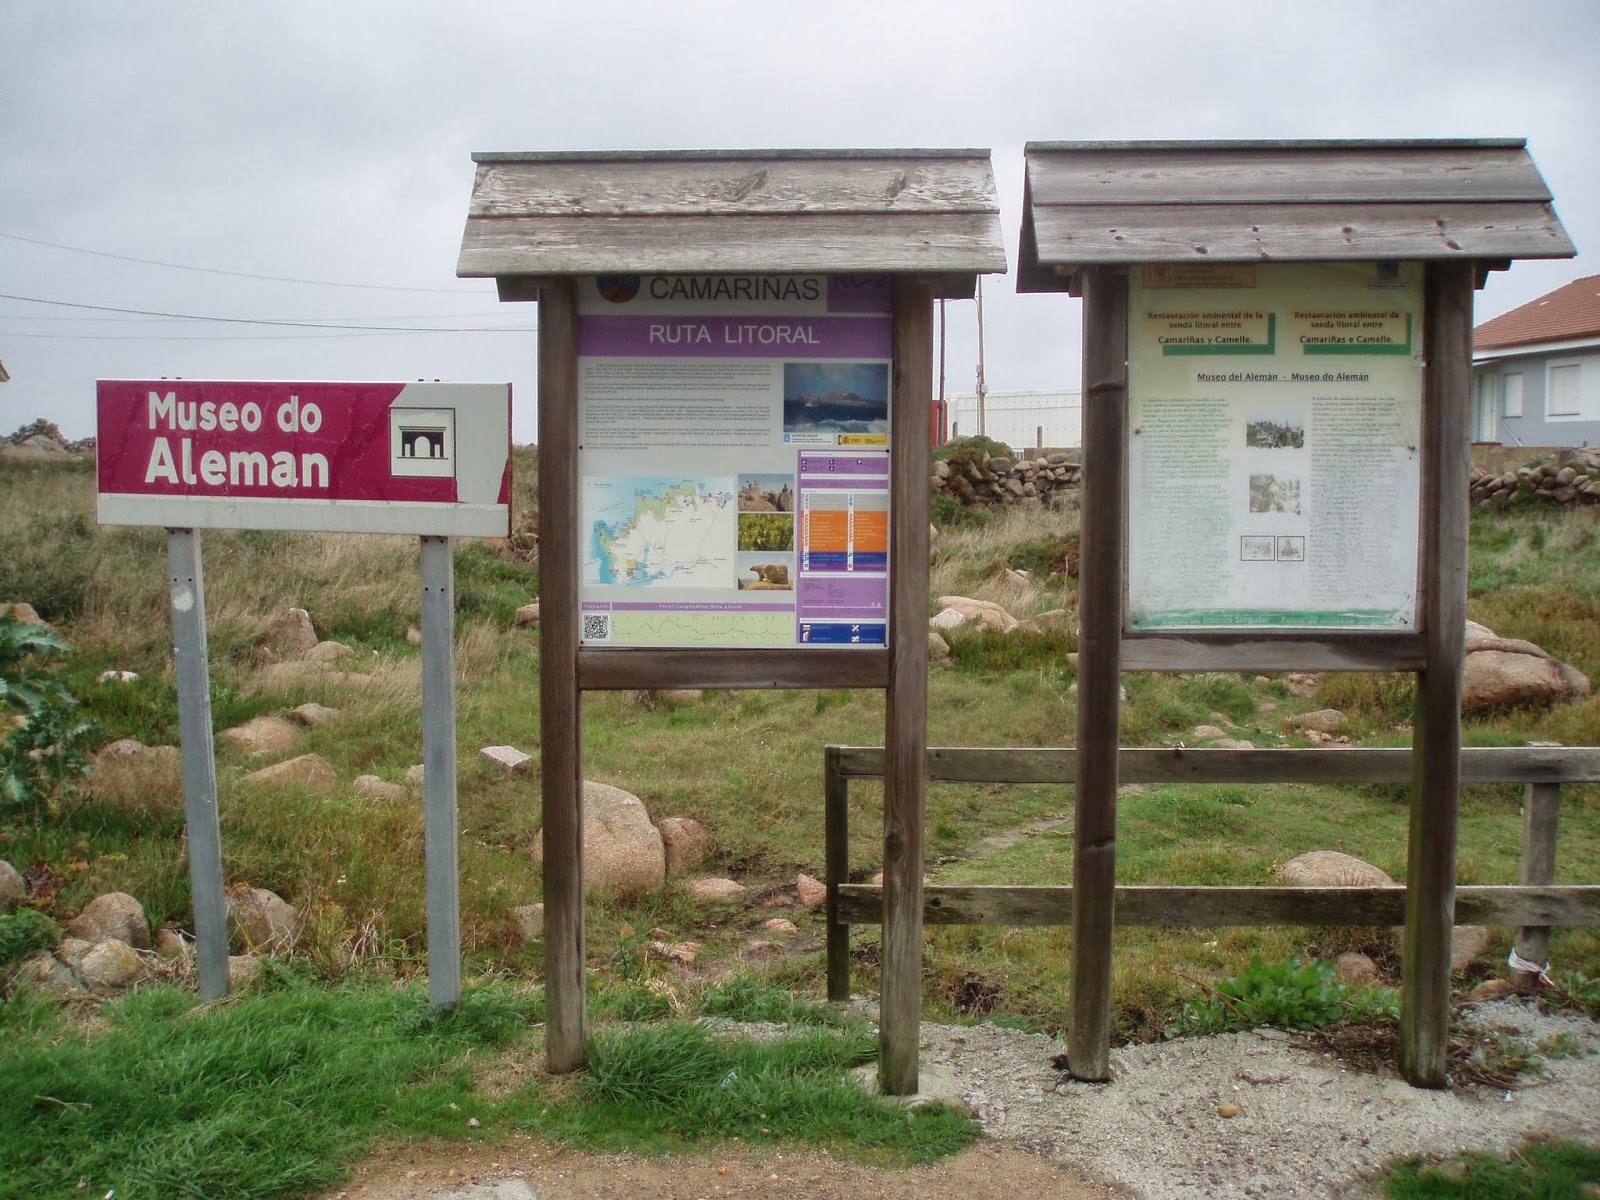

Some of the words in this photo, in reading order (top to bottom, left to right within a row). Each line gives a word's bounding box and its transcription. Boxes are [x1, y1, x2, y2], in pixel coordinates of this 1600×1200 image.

[1148, 311, 1200, 320] Restauración
[1202, 311, 1241, 320] ambiental
[1243, 311, 1254, 320] de
[1256, 311, 1264, 320] la
[1294, 311, 1346, 320] Restauración
[1348, 311, 1387, 320] ambiental
[1389, 311, 1400, 320] da
[1169, 321, 1193, 329] senda
[1195, 321, 1219, 329] litoral
[1310, 321, 1334, 329] senda
[1336, 321, 1360, 329] litoral
[650, 324, 712, 344] RUTA
[725, 325, 820, 344] LITORAL
[1158, 335, 1205, 344] Camariñas
[1207, 337, 1212, 346] y
[1215, 335, 1253, 344] Camelle.
[1300, 335, 1347, 344] Camariñas
[1356, 335, 1394, 344] Camelle.
[1197, 373, 1227, 381] Museo
[1229, 373, 1243, 381] del
[1245, 373, 1278, 381] Alemán
[1291, 373, 1321, 381] Museo
[1323, 373, 1334, 381] do
[1336, 373, 1369, 381] Alemán
[148, 391, 262, 432] Museo
[277, 395, 323, 433] do
[144, 437, 329, 488] Aleman
